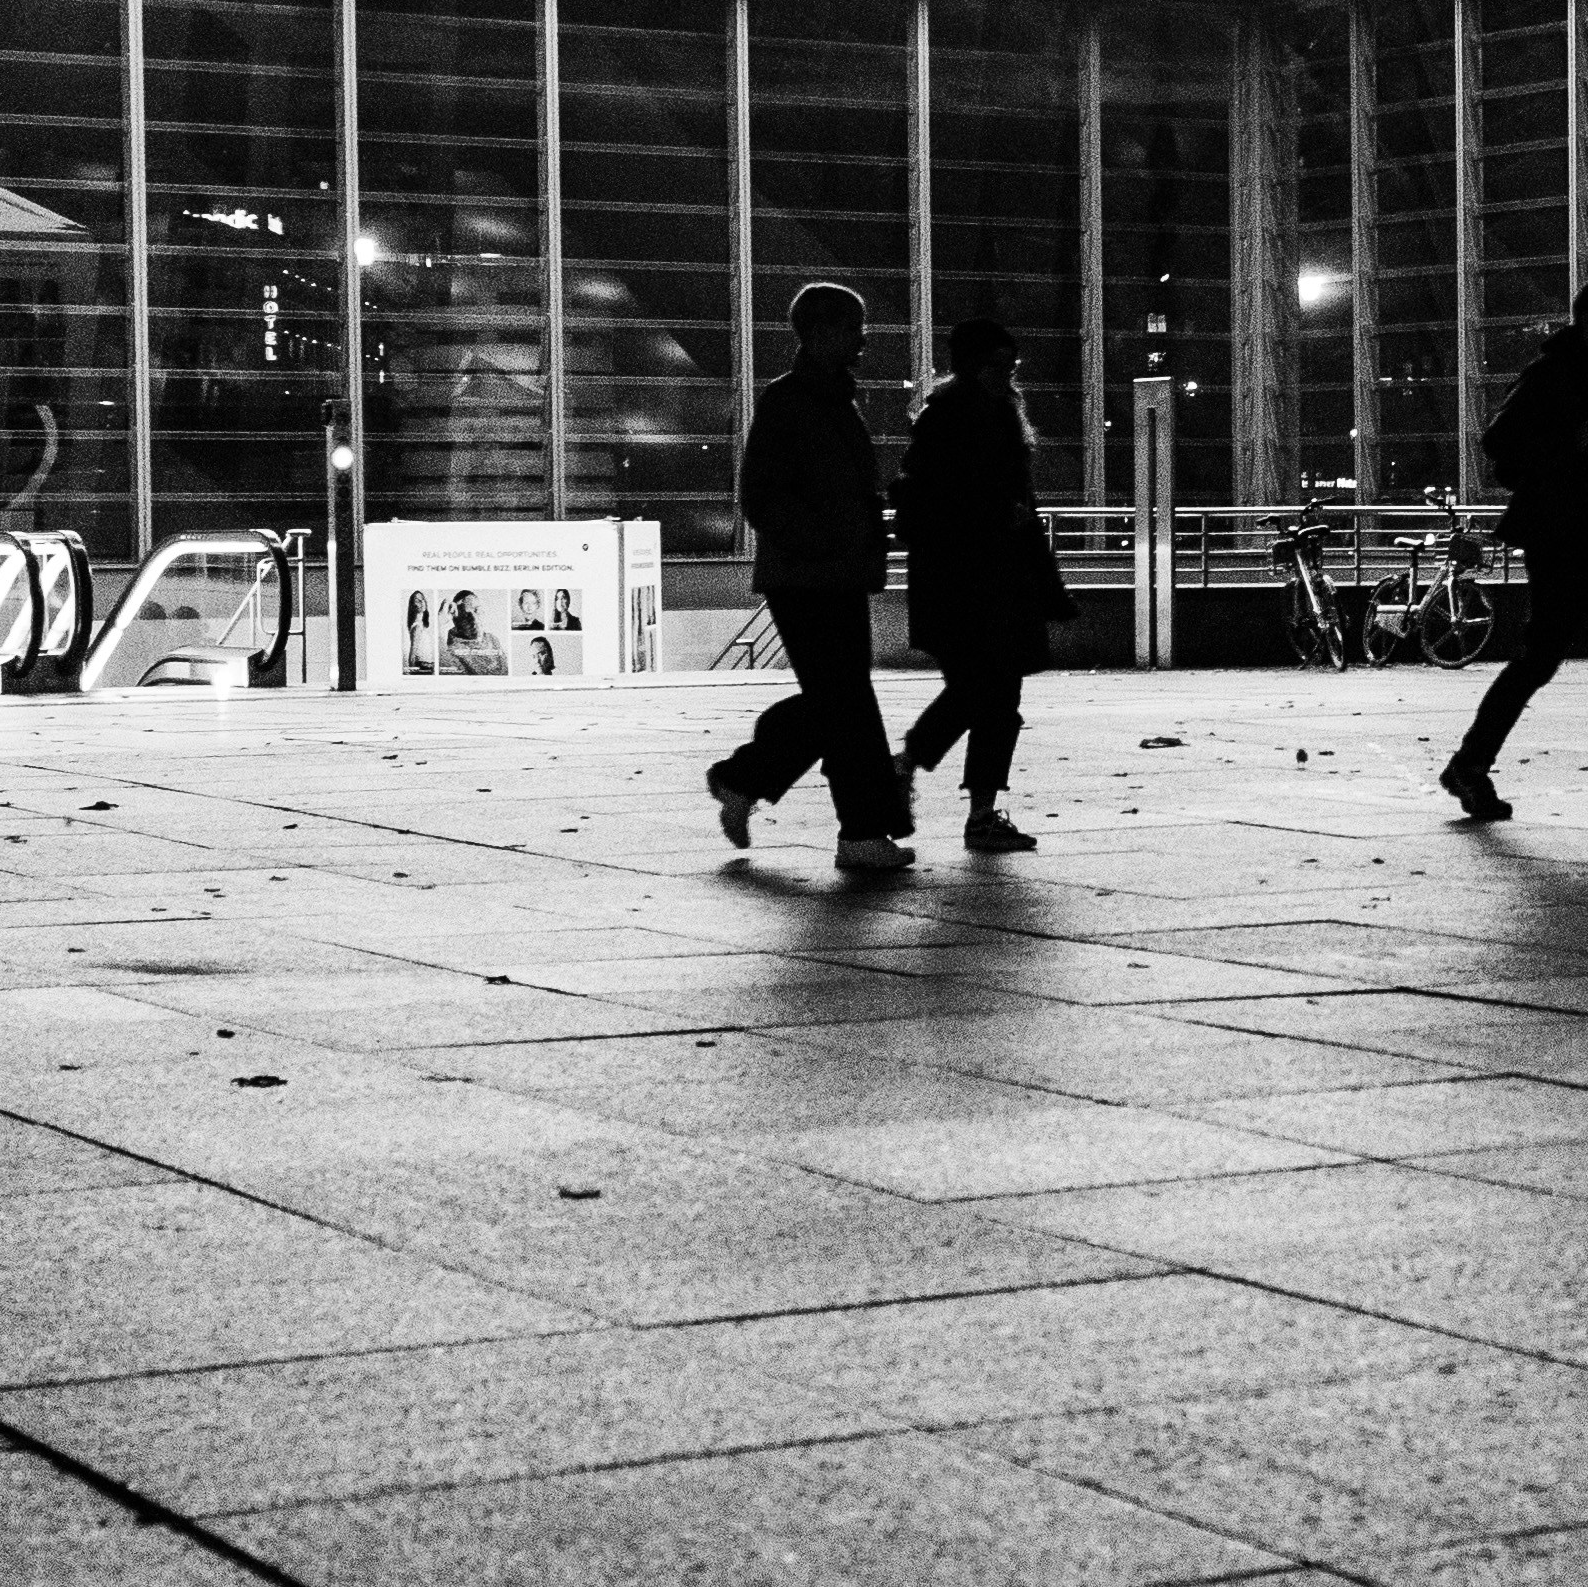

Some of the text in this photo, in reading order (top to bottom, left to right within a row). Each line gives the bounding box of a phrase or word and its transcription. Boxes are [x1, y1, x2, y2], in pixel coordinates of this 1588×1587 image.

[262, 285, 280, 361] HOTEL
[426, 564, 447, 572] THEM
[449, 564, 460, 572] ON
[461, 564, 491, 572] BUMBLE
[513, 564, 540, 572] BERLIN
